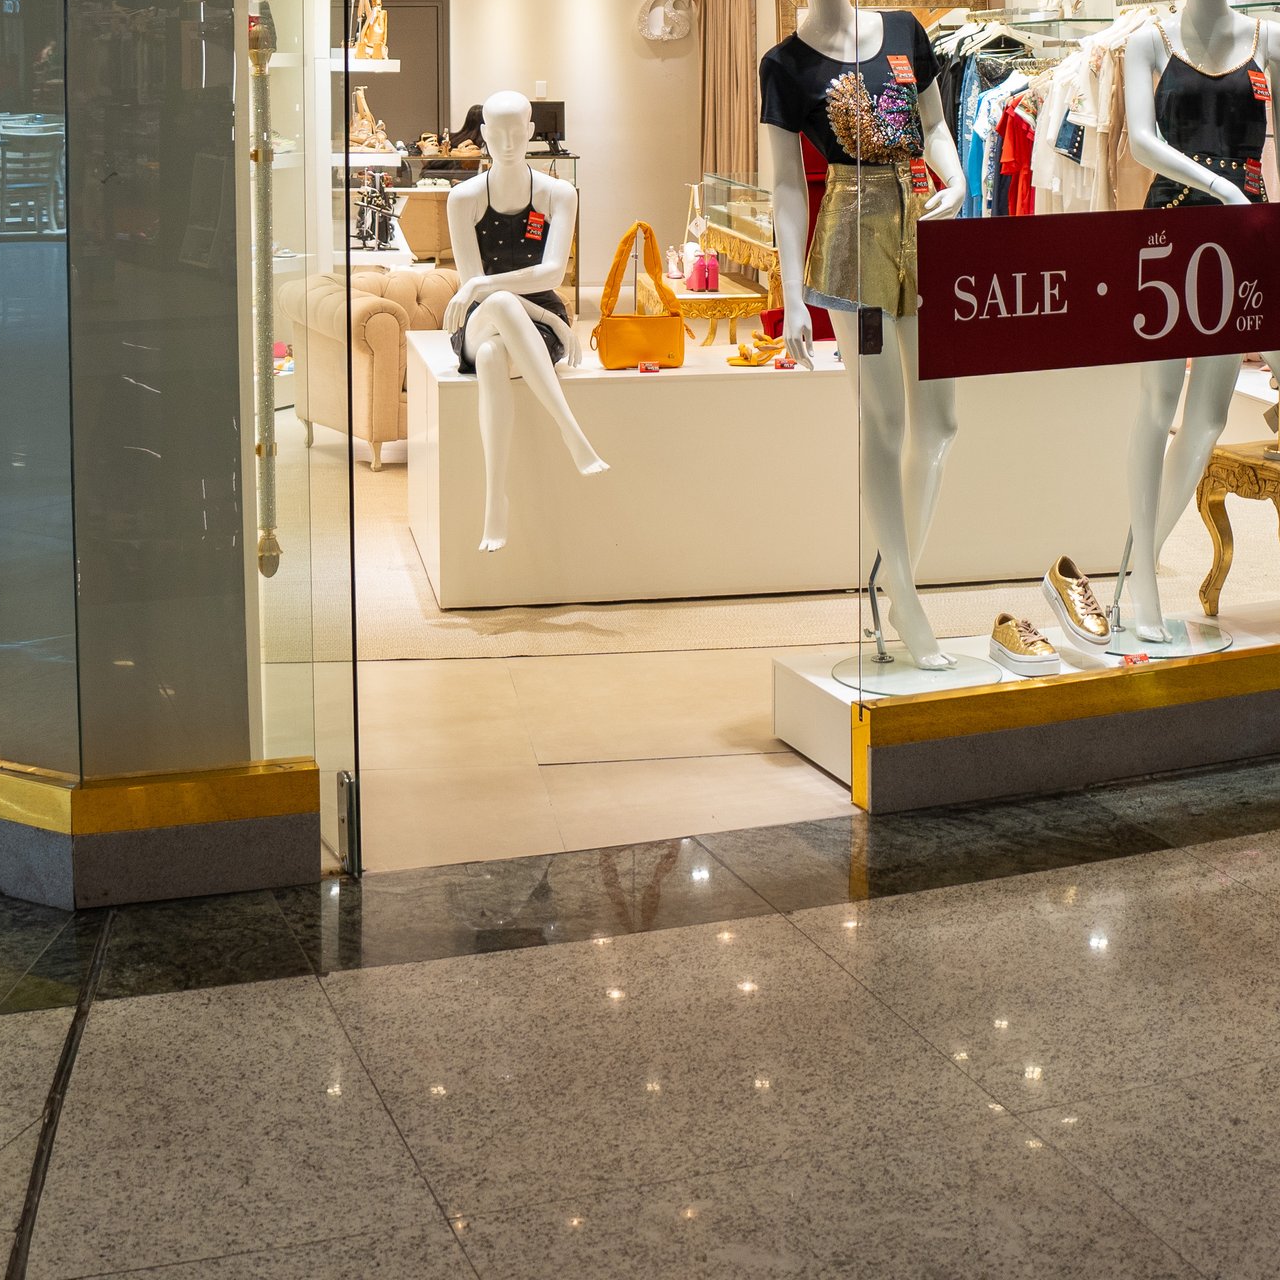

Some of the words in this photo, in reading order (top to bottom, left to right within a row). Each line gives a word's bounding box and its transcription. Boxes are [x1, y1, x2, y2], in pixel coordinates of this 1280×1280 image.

[1148, 230, 1167, 246] até
[954, 270, 1068, 321] SALE
[1236, 315, 1264, 332] OFF
